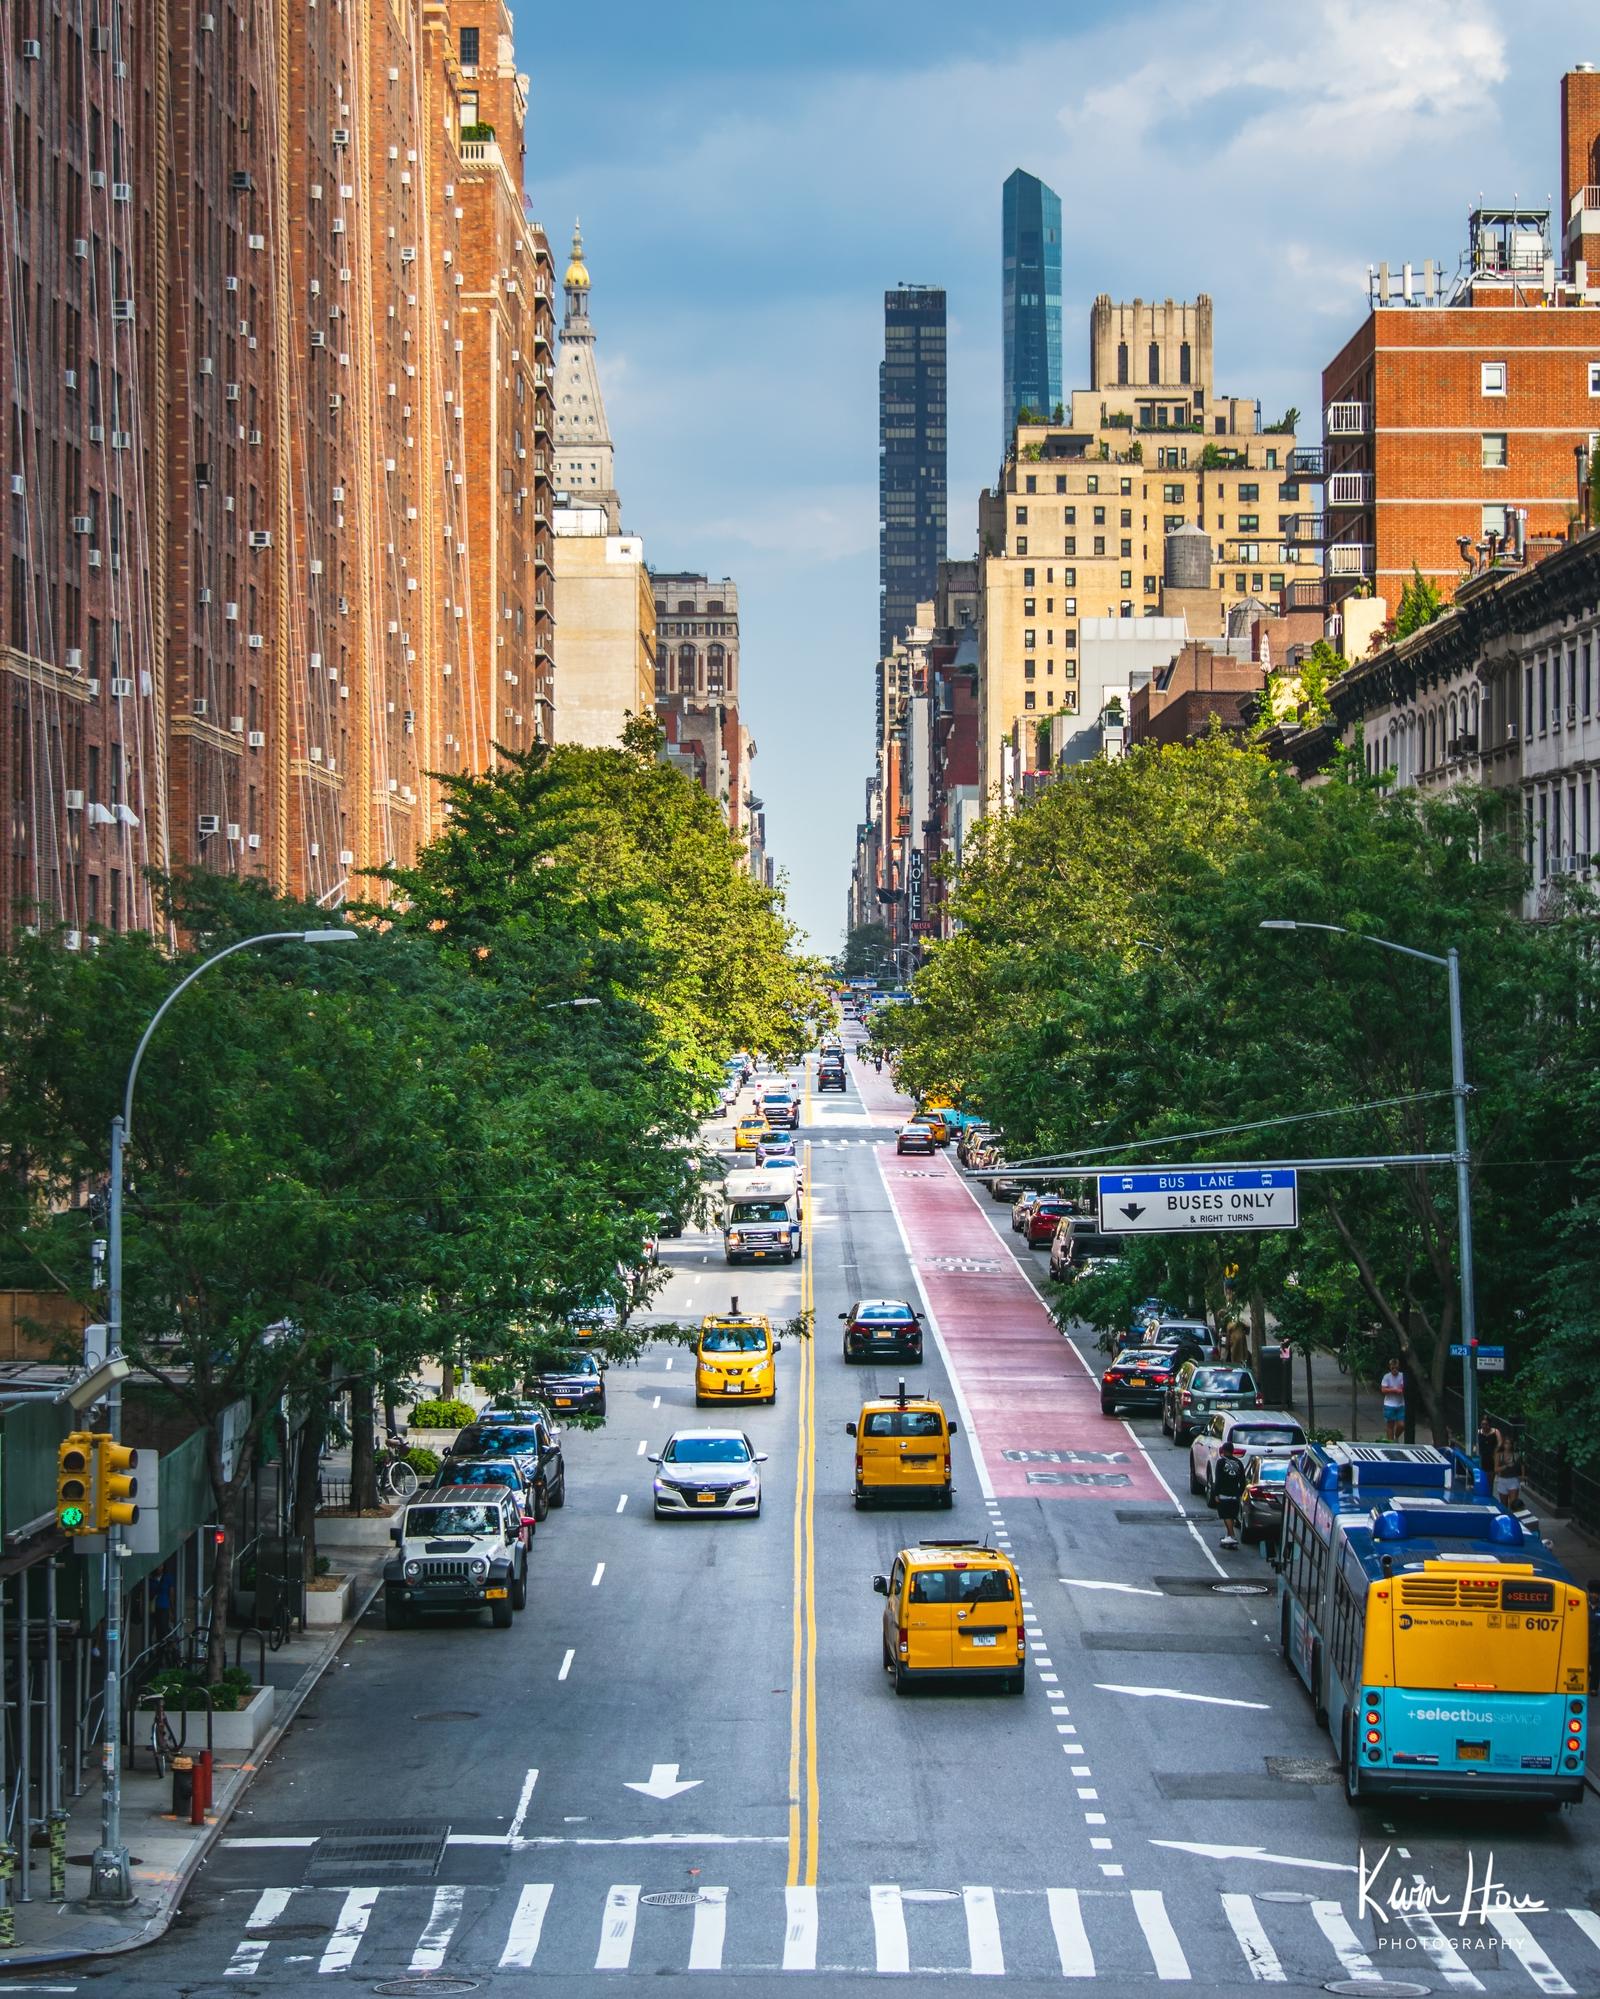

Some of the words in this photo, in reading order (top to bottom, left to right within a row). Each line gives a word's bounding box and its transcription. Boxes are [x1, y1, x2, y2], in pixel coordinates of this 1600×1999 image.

[912, 854, 921, 920] HOTEL
[1159, 1177, 1185, 1189] BUS
[1199, 1175, 1235, 1188] LANE
[1167, 1194, 1223, 1210] BUSES
[1231, 1193, 1275, 1209] ONLY
[1189, 1215, 1197, 1223] &
[1200, 1214, 1223, 1223] RIGHT
[1227, 1213, 1254, 1222] TURNS
[1451, 1347, 1468, 1356] M23
[1002, 1450, 1127, 1464] ONLY
[1446, 1619, 1459, 1627] City
[1526, 1617, 1559, 1631] 6107
